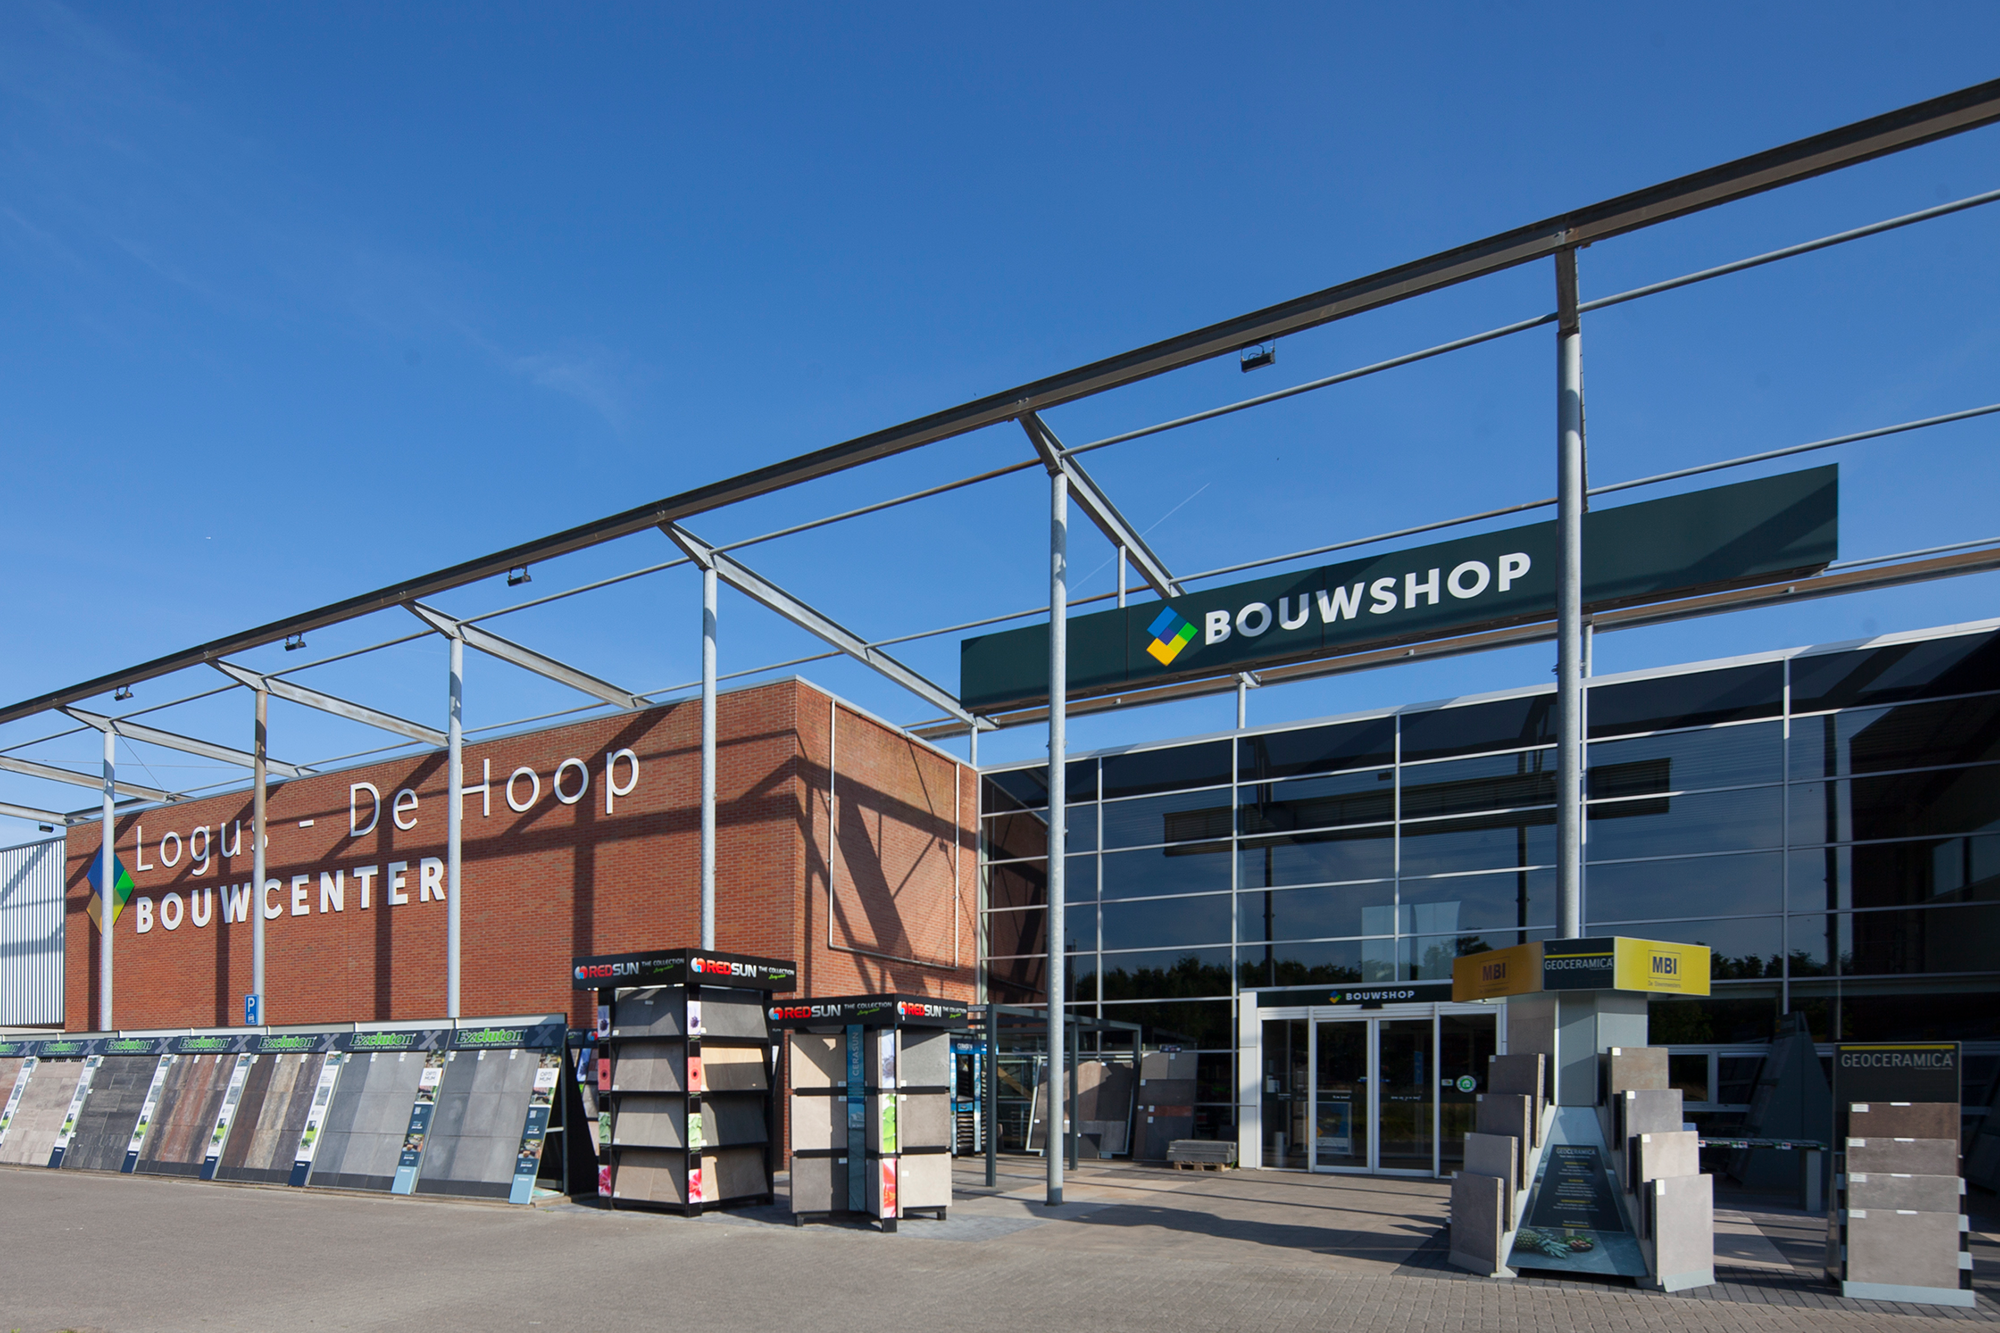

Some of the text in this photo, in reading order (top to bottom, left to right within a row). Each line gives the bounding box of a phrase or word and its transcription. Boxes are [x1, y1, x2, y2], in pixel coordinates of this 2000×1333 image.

[1205, 552, 1531, 645] BOUWSHOP
[350, 781, 419, 838] De
[460, 747, 640, 820] Hoop
[136, 856, 446, 934] BOUWCENTER
[588, 961, 640, 979] REDSUN
[706, 959, 757, 979] REDSUN
[1482, 962, 1506, 981] MBI
[1544, 957, 1613, 970] GEOCERAMICA
[1652, 955, 1677, 975] MBI
[1345, 990, 1415, 1001] BOUWSHOP
[247, 997, 256, 1013] P
[784, 1004, 842, 1019] REDSUN
[856, 1001, 893, 1010] COLLECTION
[907, 1002, 942, 1018] REDSUN
[179, 1036, 229, 1049] Excluton
[258, 1035, 315, 1049] Excluton
[350, 1032, 415, 1046] Excluton
[455, 1028, 525, 1044] Excluton
[105, 1038, 153, 1051] Excluton
[1841, 1053, 1953, 1068] GEOCERAMICA
